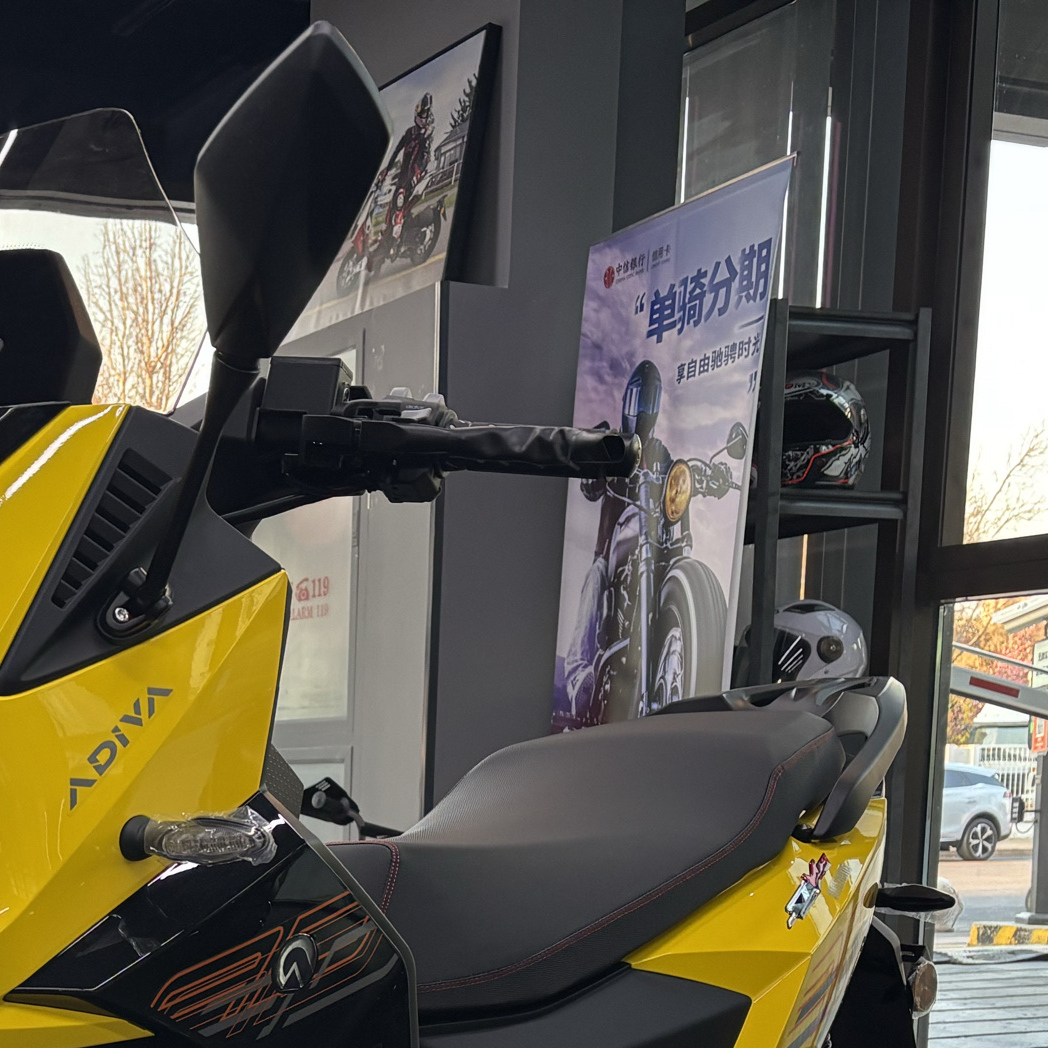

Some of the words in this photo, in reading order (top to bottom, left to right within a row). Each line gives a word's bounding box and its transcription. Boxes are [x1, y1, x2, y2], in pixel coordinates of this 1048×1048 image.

[615, 253, 646, 276] 中信银行
[676, 332, 761, 385] 享自由驰骋时光
[311, 576, 330, 599] 119
[69, 686, 174, 811] ADIVA
